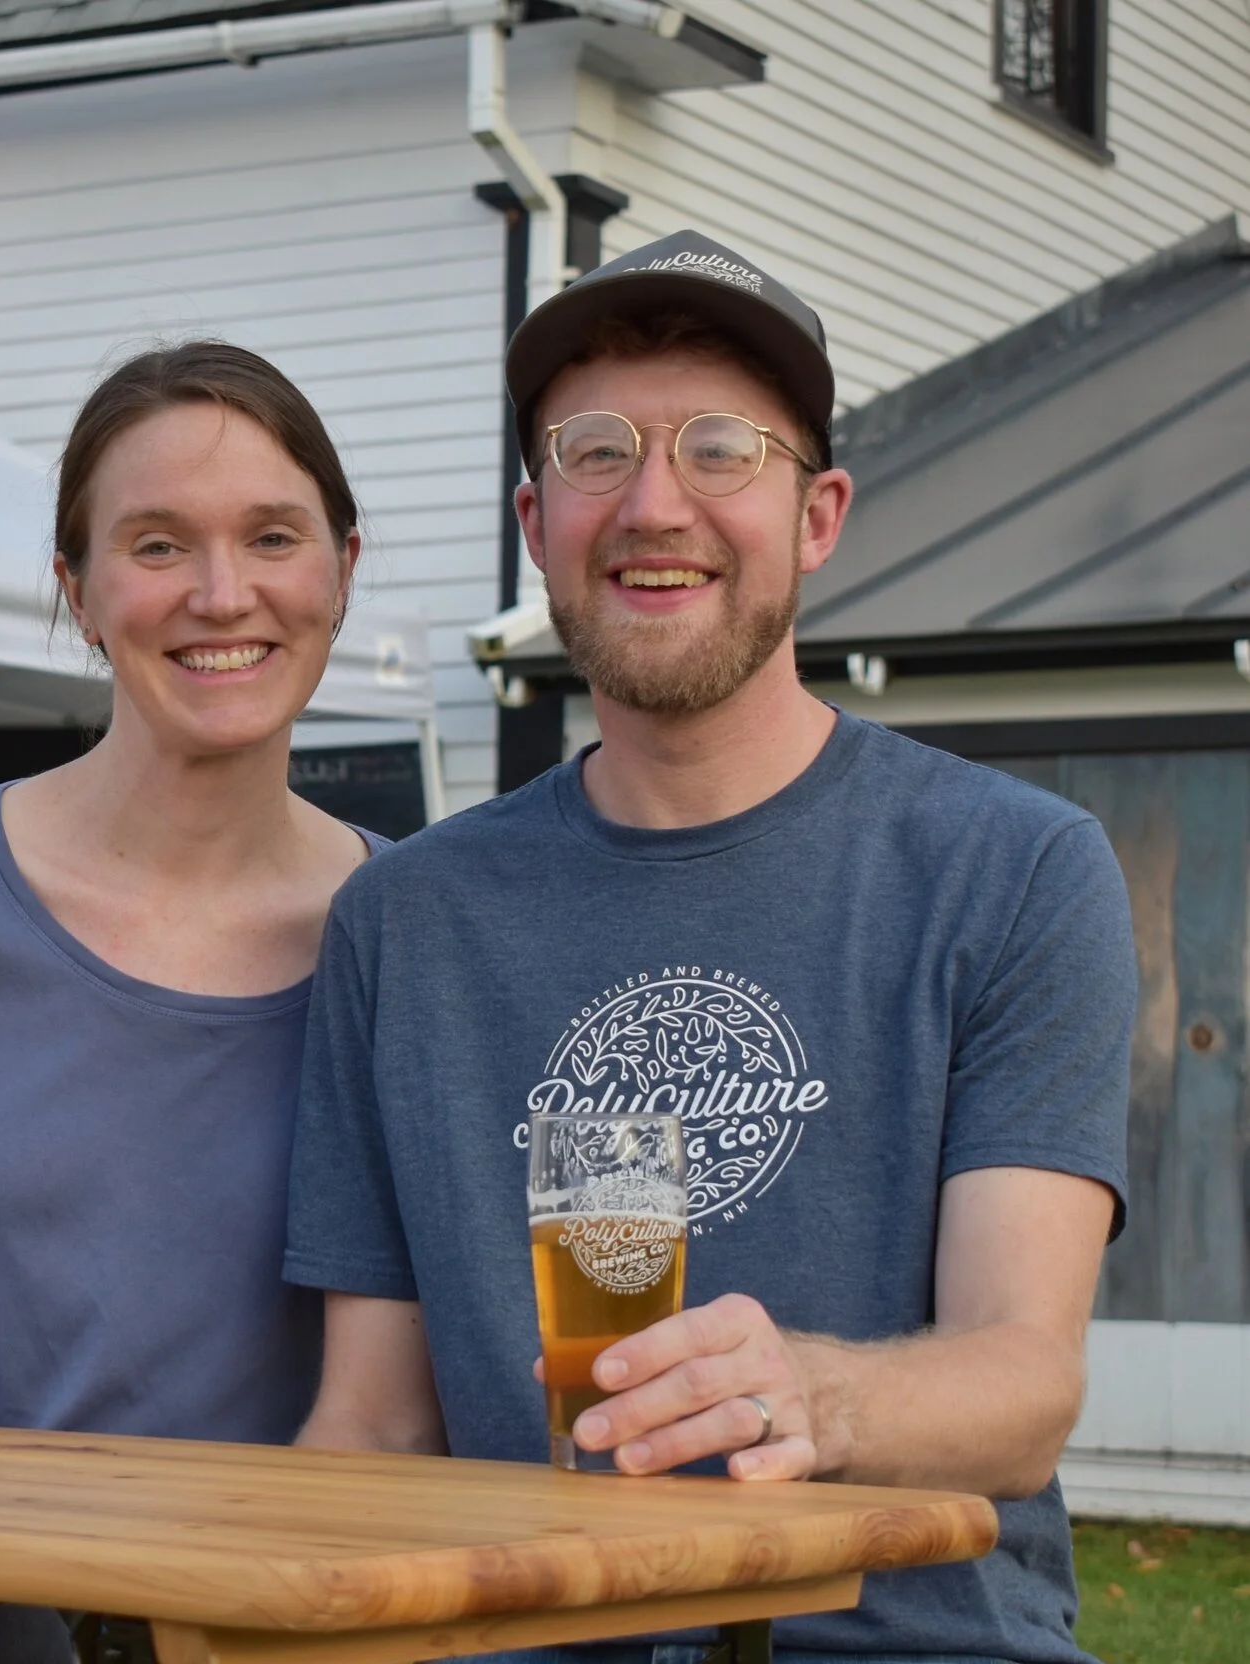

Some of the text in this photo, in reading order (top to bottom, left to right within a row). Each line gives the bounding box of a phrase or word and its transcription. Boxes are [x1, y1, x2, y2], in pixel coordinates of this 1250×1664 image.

[623, 251, 764, 286] lyCulture
[571, 966, 780, 1027] BOTTLED AND BREWED
[718, 1123, 767, 1150] CO.
[592, 1247, 647, 1270] BREWING
